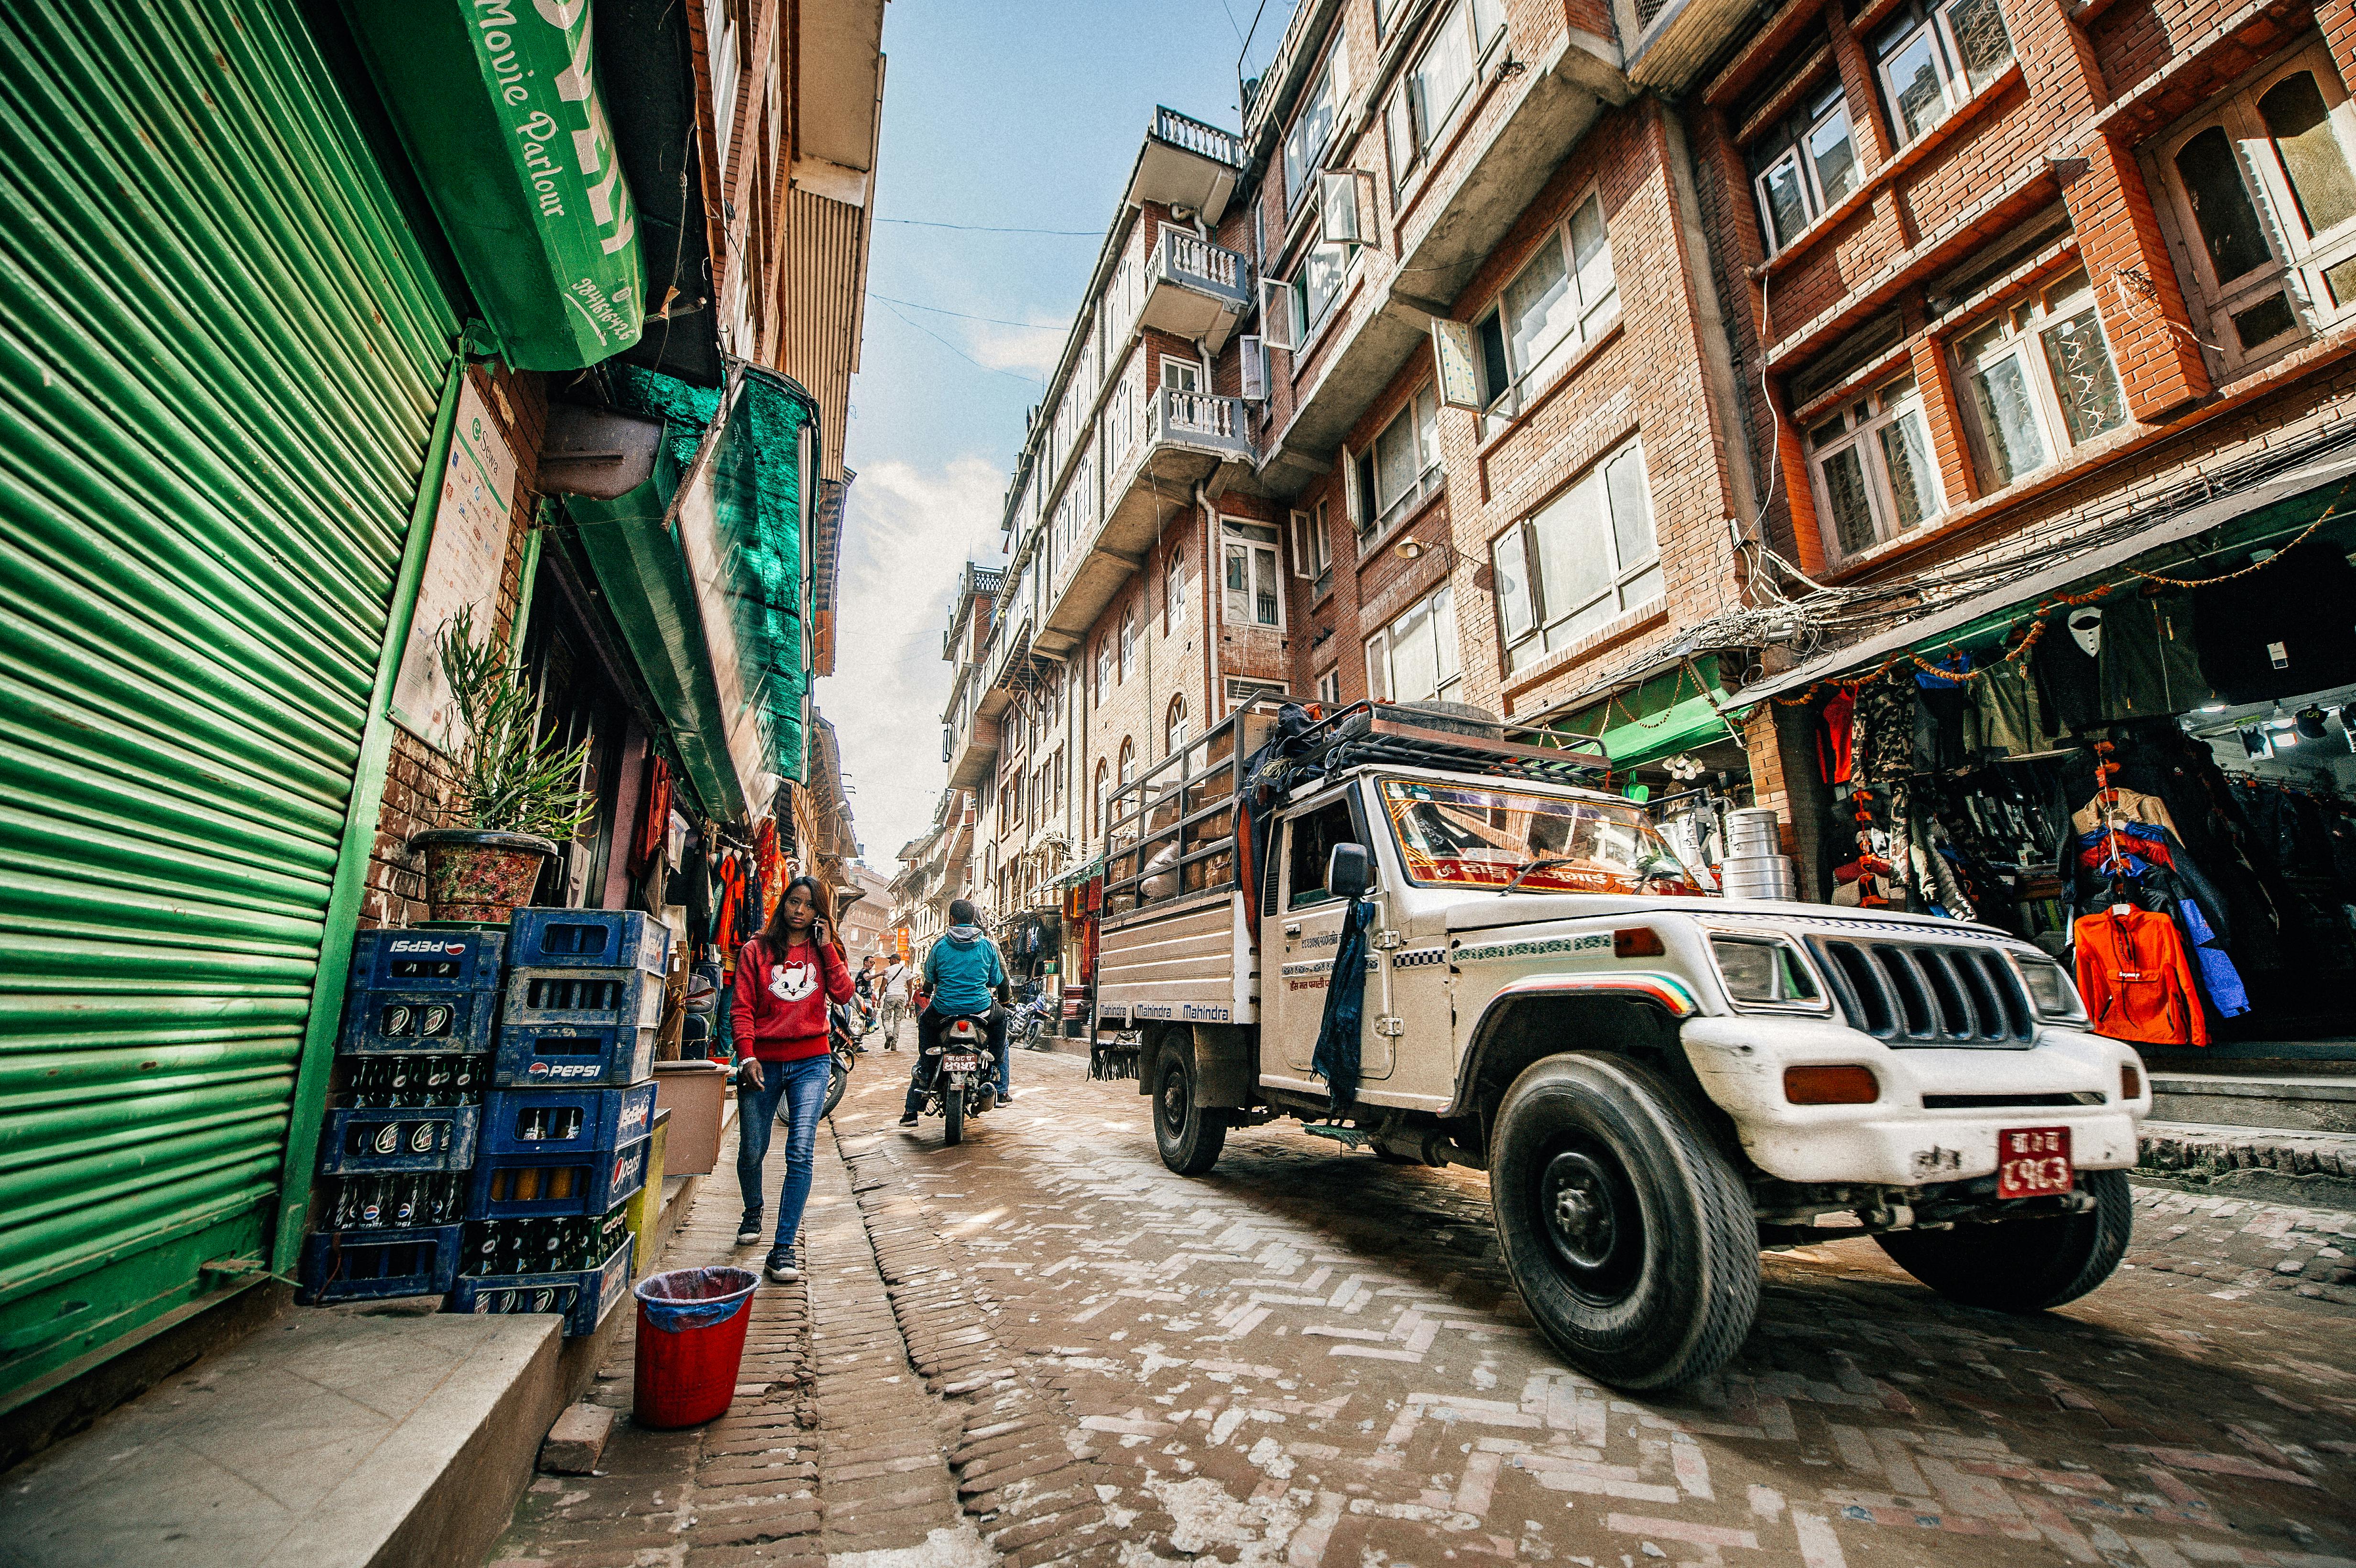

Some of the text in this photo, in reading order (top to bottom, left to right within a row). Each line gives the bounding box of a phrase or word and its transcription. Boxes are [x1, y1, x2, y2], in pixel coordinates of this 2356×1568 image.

[475, 0, 565, 217] Movie Parlour
[571, 278, 635, 341] 9841616426
[763, 740, 778, 773] PIN
[390, 940, 444, 952] PEPSI
[1100, 1004, 1228, 1021] Mahindra Mahindra Mahindra
[549, 1065, 601, 1077] PEPSI
[622, 1150, 642, 1184] pepsi
